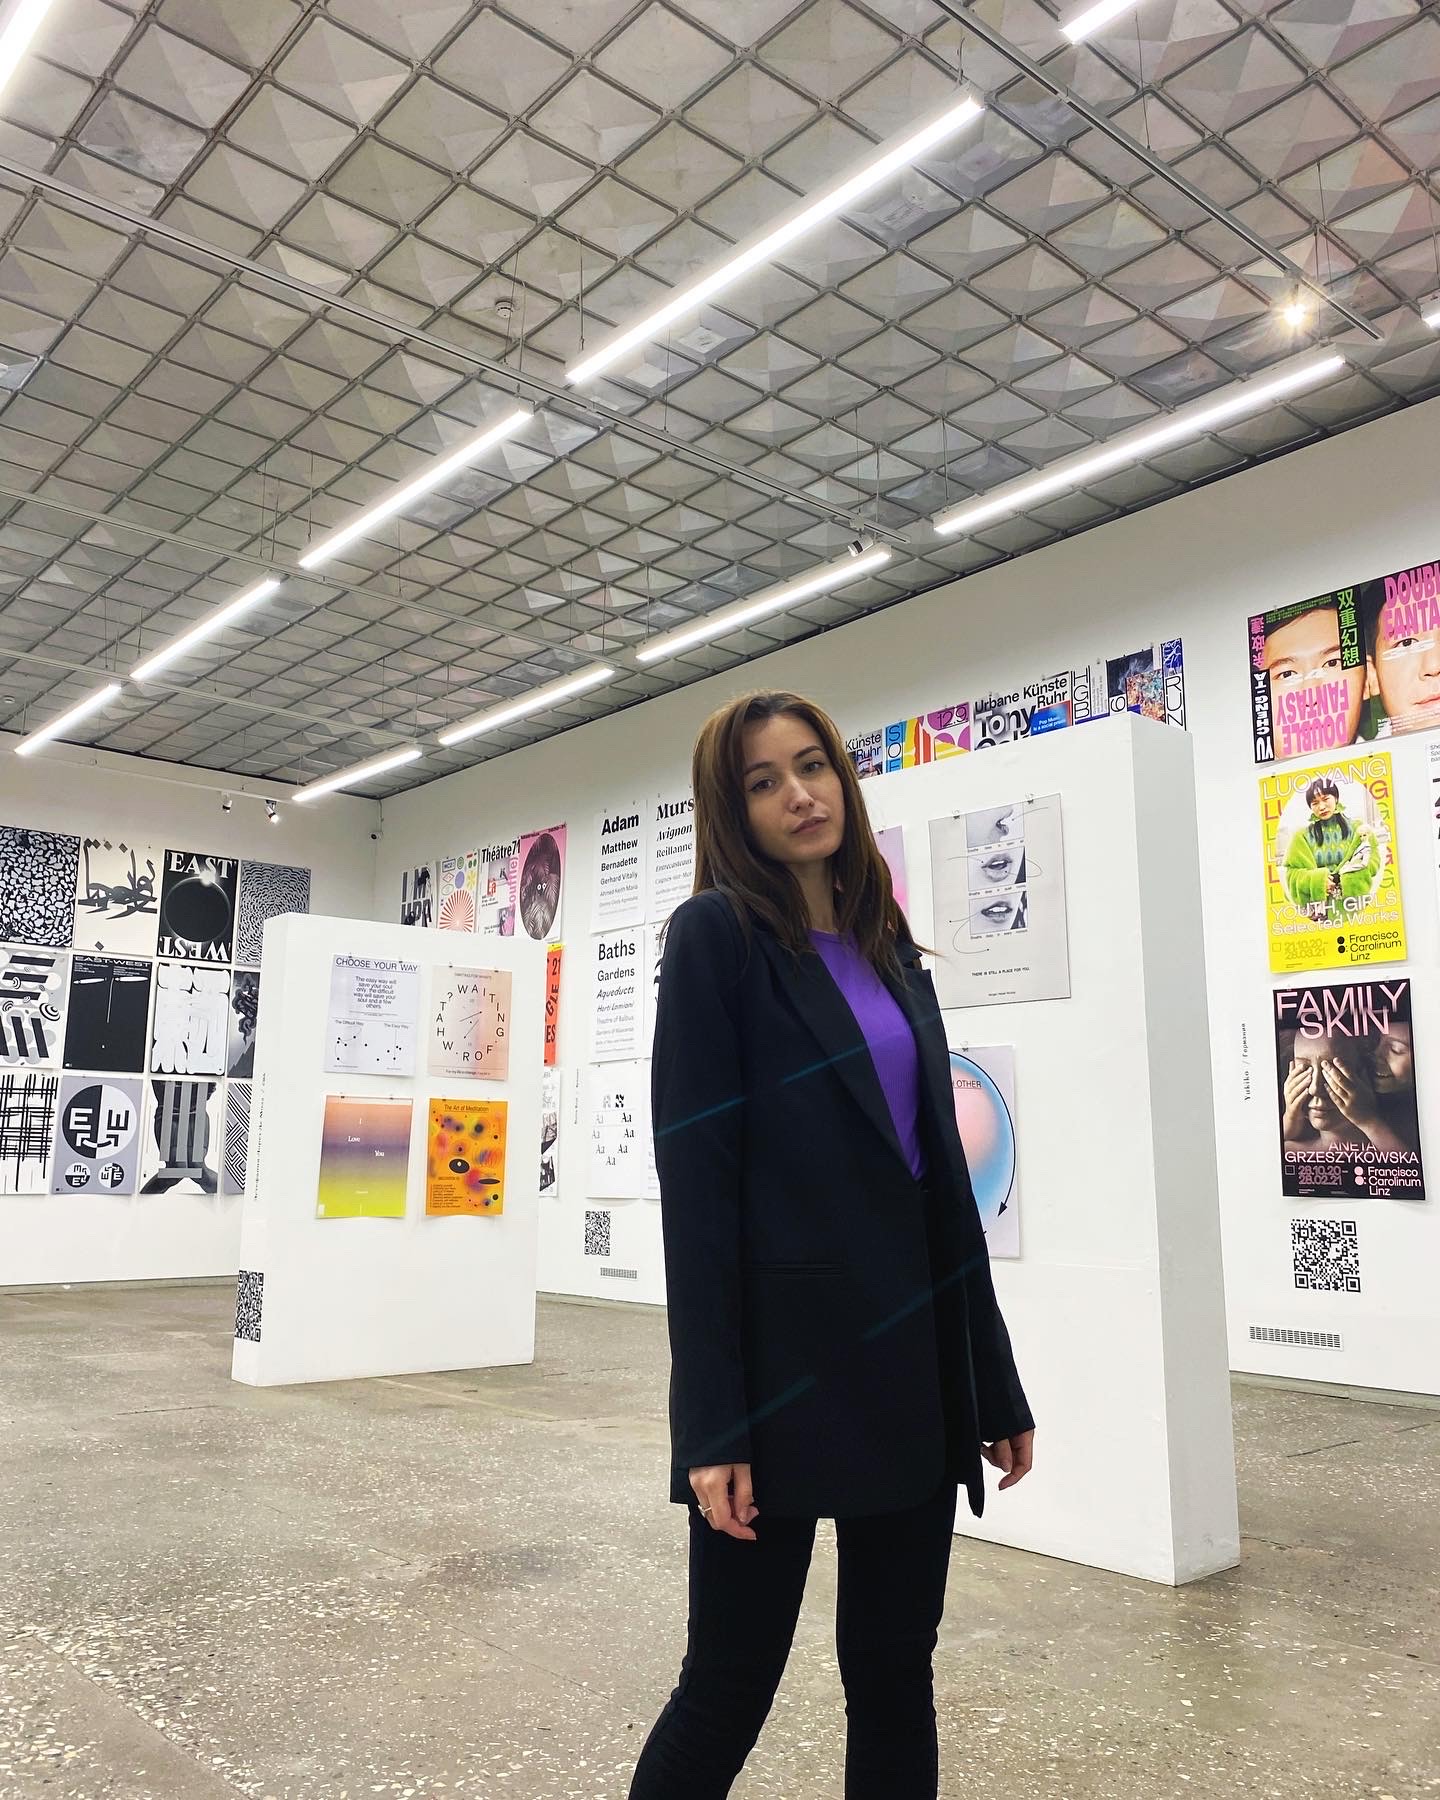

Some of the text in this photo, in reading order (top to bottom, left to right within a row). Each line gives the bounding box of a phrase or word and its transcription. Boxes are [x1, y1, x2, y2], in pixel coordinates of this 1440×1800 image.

[1337, 588, 1360, 667] 双重幻想
[975, 692, 1020, 713] Urbane
[1023, 677, 1068, 699] Künste
[1037, 691, 1068, 708] Ruhr
[1276, 679, 1350, 726] FANTASY
[975, 705, 1037, 738] Tony
[845, 733, 882, 752] Künste
[1282, 712, 1348, 755] DOUBLE
[856, 746, 882, 761] Ruhr
[1263, 758, 1388, 800] LUO YANG
[656, 798, 695, 821] Murs
[601, 814, 640, 836] Adam
[656, 823, 693, 841] Avignon
[601, 838, 639, 856] Matthew
[656, 842, 693, 858] Reillanne
[600, 856, 638, 872] Bernadette
[600, 874, 621, 886] Gerhard
[1271, 890, 1397, 921] YOUTH, GIRLS
[1271, 909, 1399, 936] Selected Works
[1349, 930, 1399, 944] Francisco
[1350, 939, 1402, 953] Carolinum
[598, 939, 636, 961] Baths
[1350, 952, 1370, 961] Linz
[335, 957, 418, 972] CHOOSE YOUR WAY
[597, 967, 635, 981] Gardens
[596, 986, 634, 1000] Aqueducts
[1276, 982, 1407, 1020] FAMILY
[1299, 1006, 1391, 1039] SKIN
[1241, 1023, 1249, 1058] Германия
[956, 1079, 982, 1088] OTHER
[1284, 1151, 1420, 1163] GRZESZYKOWSKA
[1368, 1166, 1418, 1177] Francisco
[1368, 1176, 1421, 1187] Carolinum
[1369, 1186, 1391, 1196] Linz
